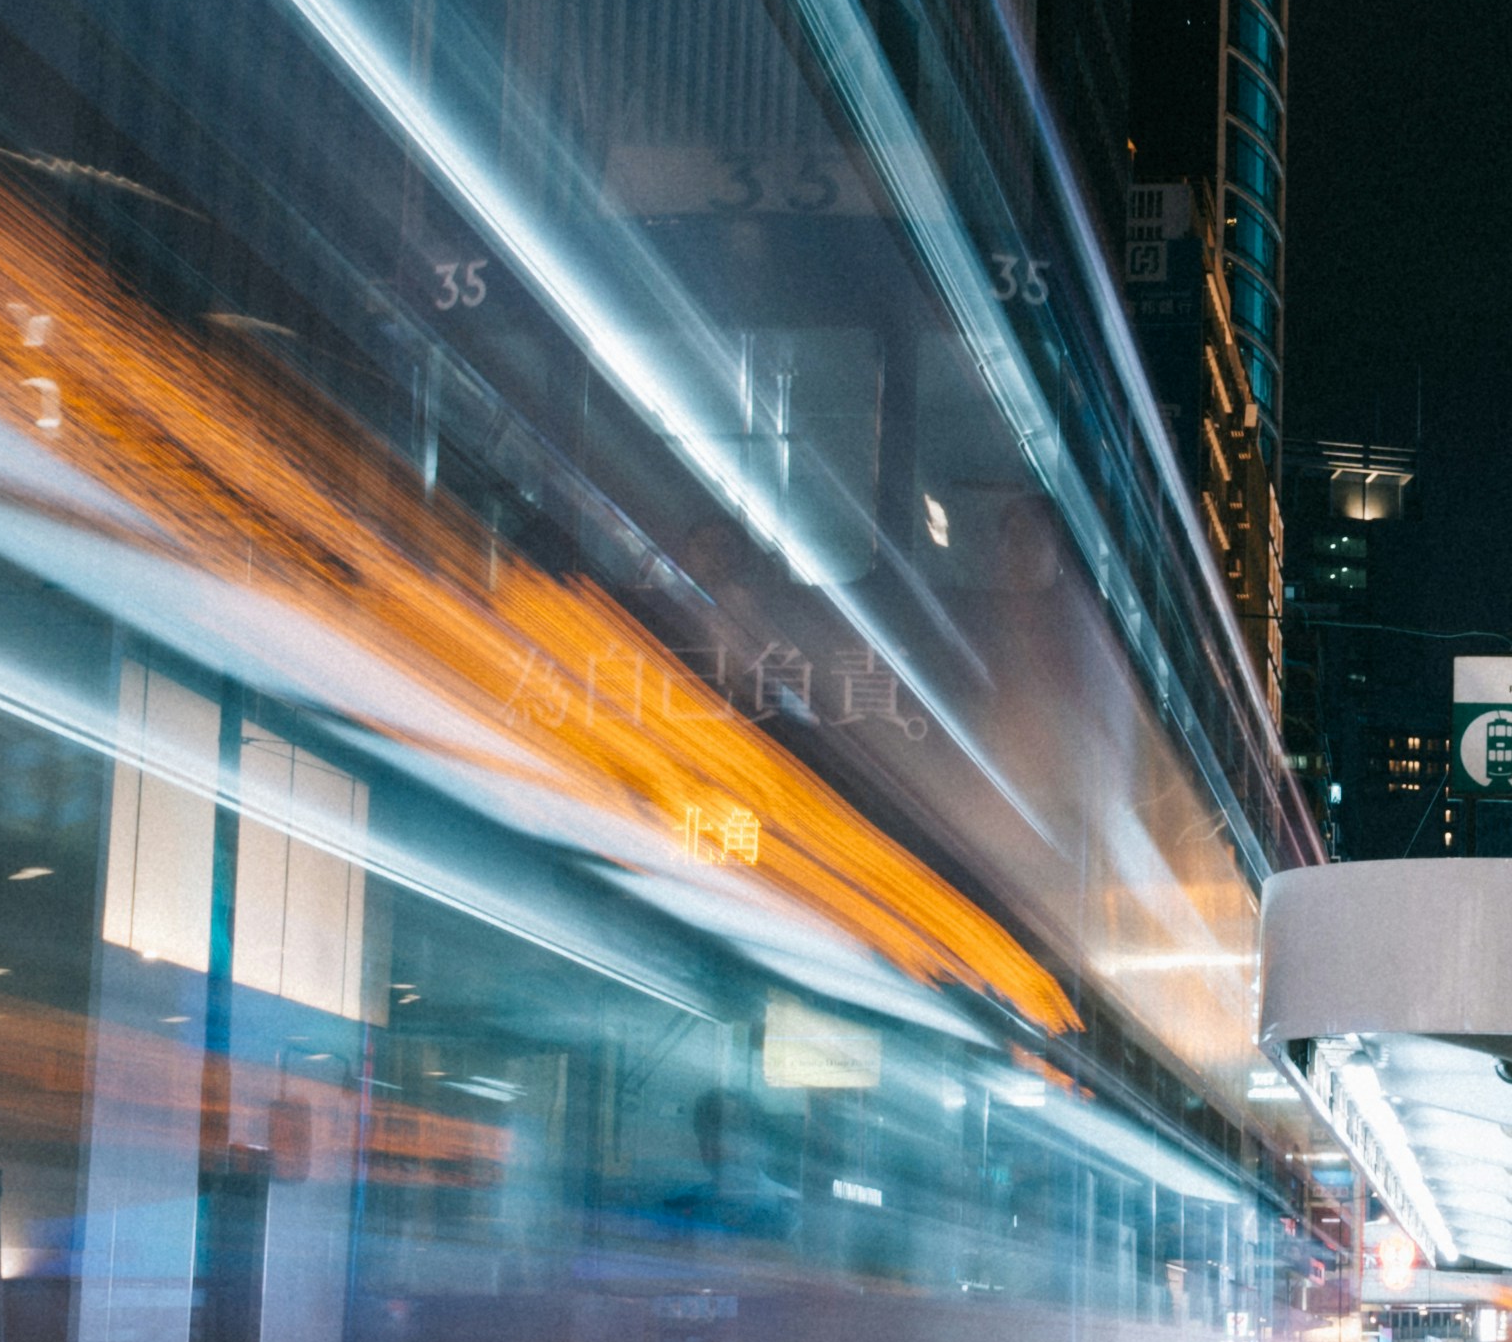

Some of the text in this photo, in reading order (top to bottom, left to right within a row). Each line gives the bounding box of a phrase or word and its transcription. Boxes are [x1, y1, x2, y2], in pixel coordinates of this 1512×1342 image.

[433, 261, 488, 310] 35
[989, 253, 1051, 306] 35
[671, 805, 762, 866] 北角
